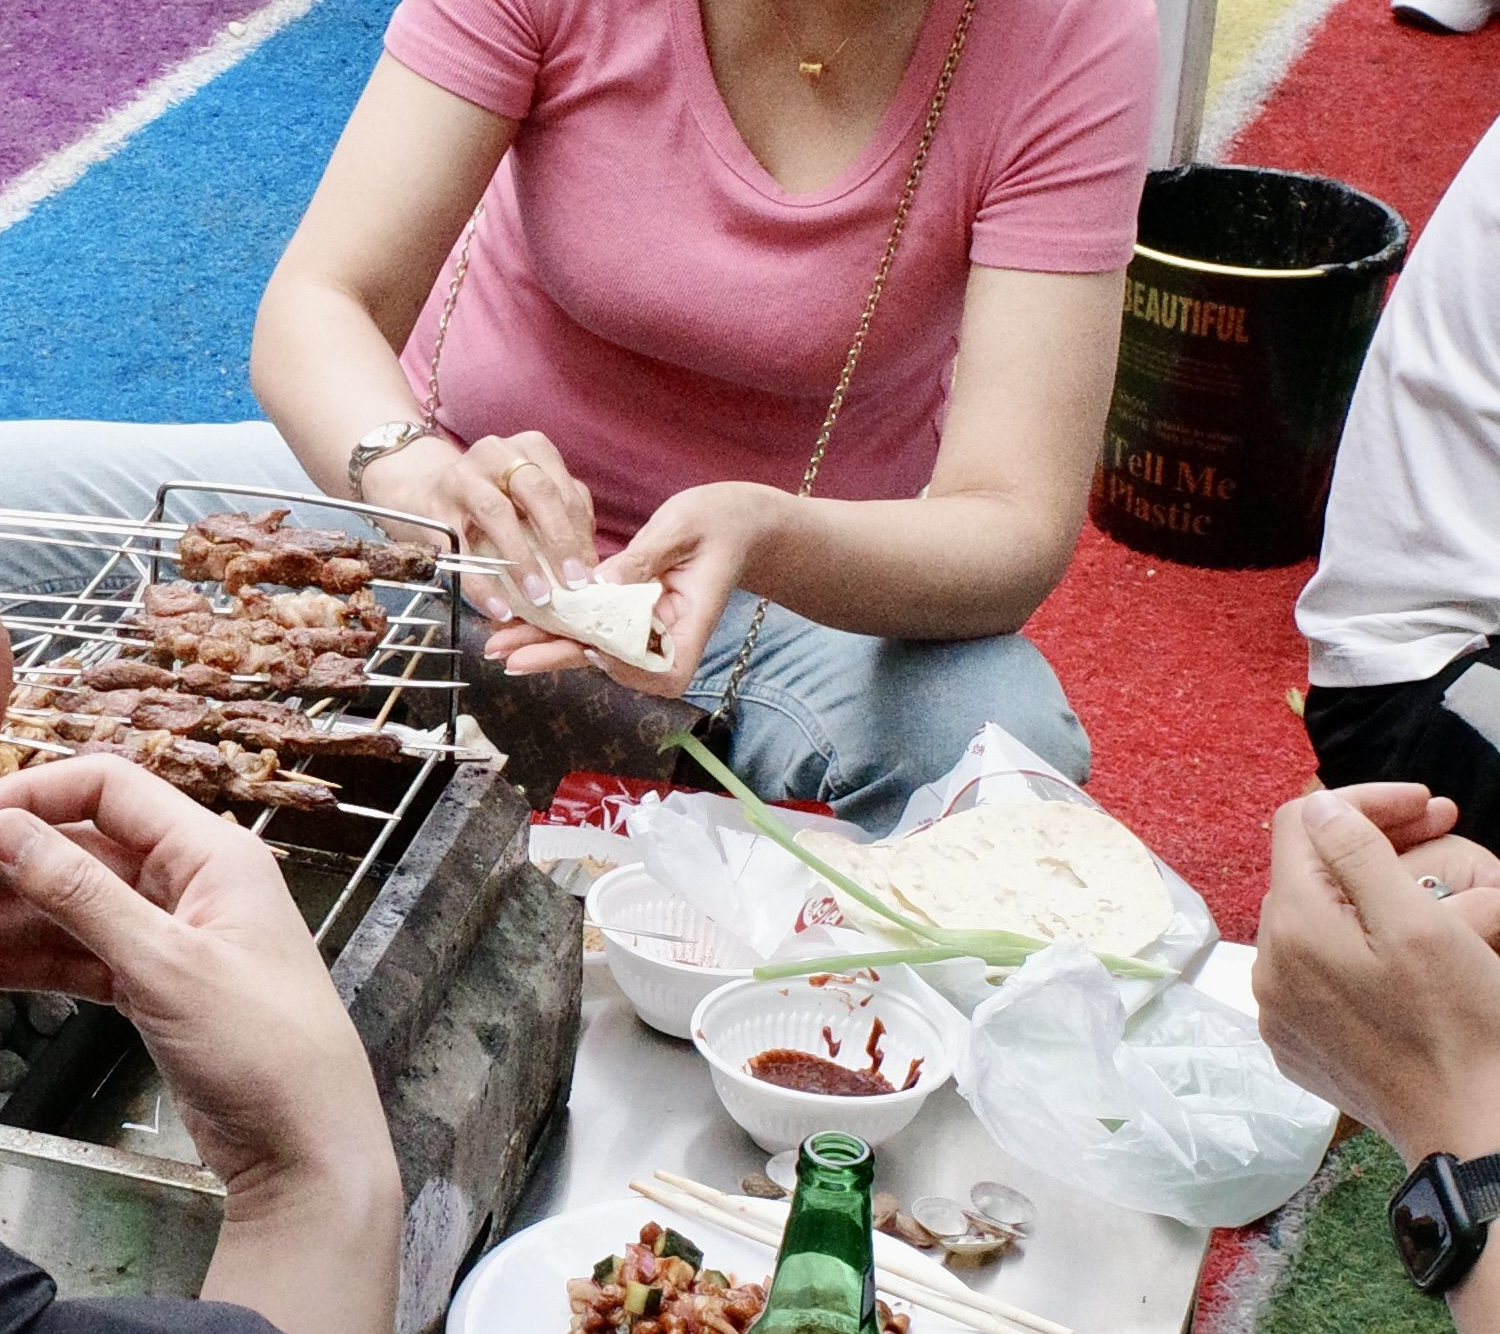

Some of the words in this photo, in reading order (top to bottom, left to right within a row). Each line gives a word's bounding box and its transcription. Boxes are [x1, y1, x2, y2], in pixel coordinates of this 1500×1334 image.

[1124, 278, 1249, 344] BEAUTIFUL
[1110, 432, 1164, 487] Tell
[1176, 460, 1238, 500] Me
[1109, 473, 1213, 535] Plastic
